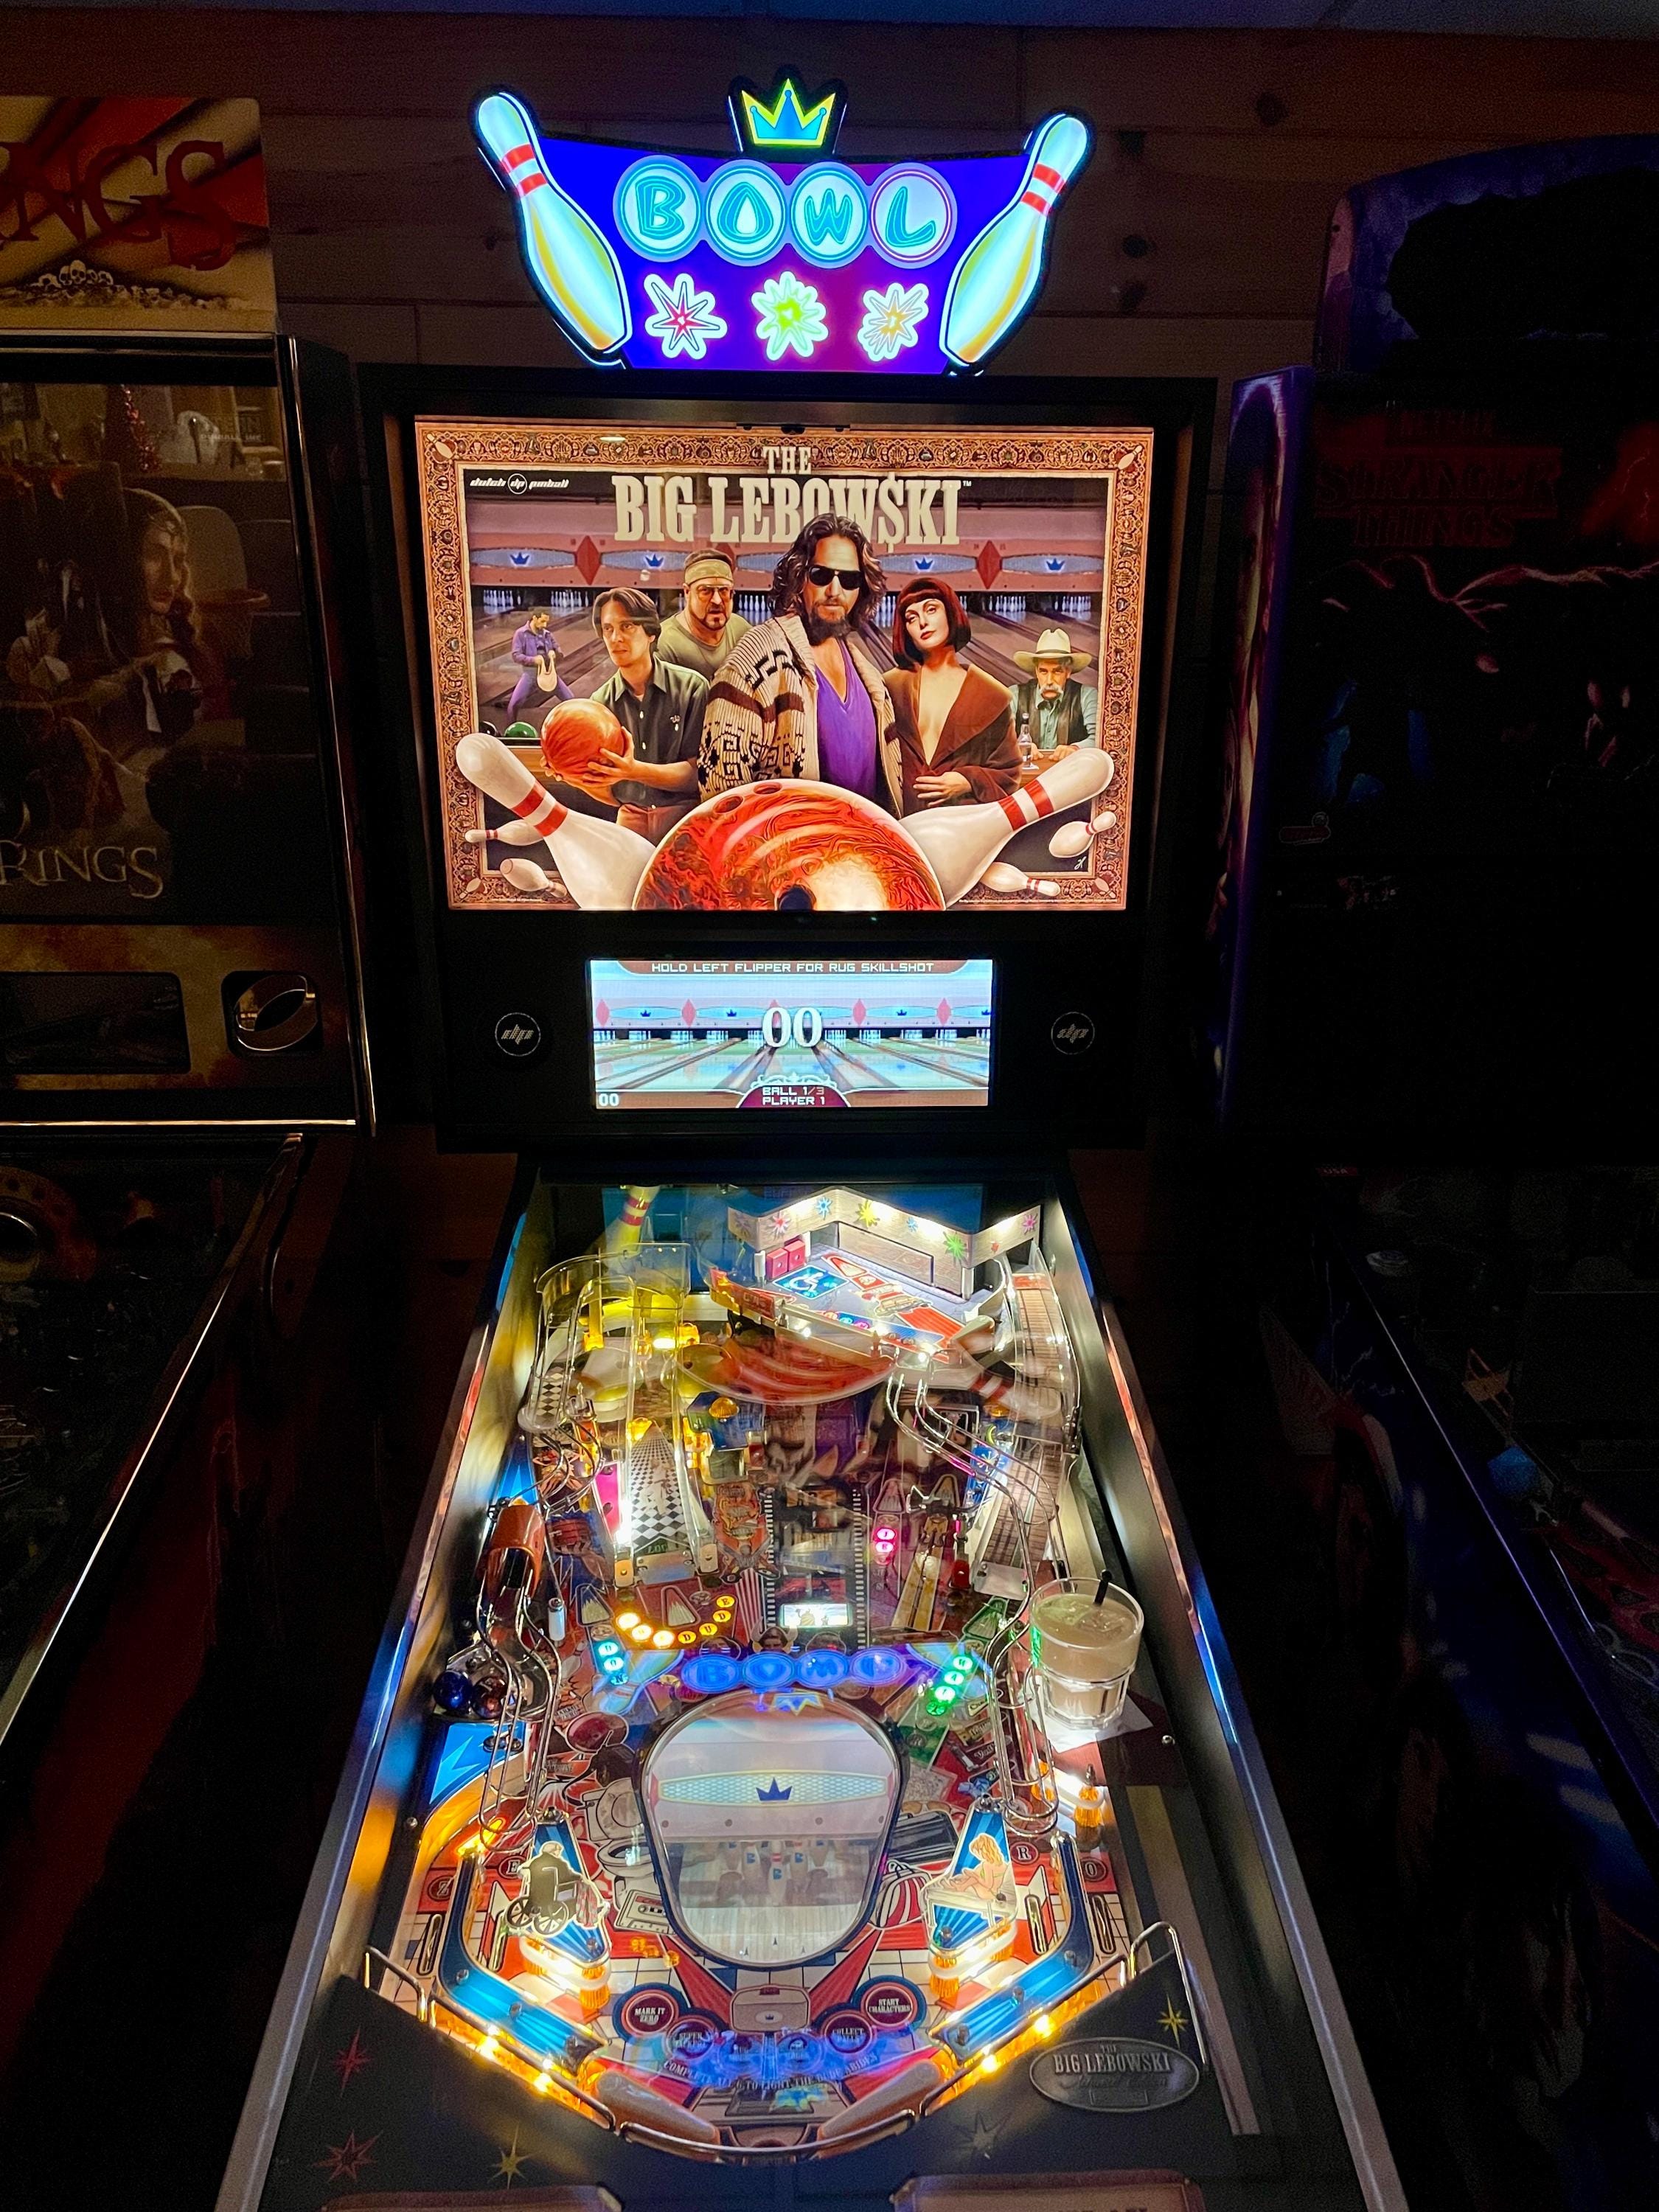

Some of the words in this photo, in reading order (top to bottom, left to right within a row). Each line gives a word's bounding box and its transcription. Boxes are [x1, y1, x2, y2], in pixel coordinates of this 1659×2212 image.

[0, 140, 237, 271] NGS
[633, 179, 936, 248] BOWL
[762, 446, 812, 474] THE
[611, 476, 697, 543] BIG
[651, 963, 688, 973] HOLD
[693, 963, 728, 973] LEFT
[734, 963, 791, 973] FLIPPER
[796, 963, 824, 972] FOR
[829, 963, 856, 972] RUG
[860, 962, 935, 972] SKILLSHOT
[762, 1006, 823, 1048] 00
[762, 1087, 798, 1096] BALL
[802, 1087, 825, 1096] 1/3
[598, 1093, 619, 1107] 00
[762, 1096, 815, 1105] PLAYER
[820, 1096, 825, 1105] 1
[1016, 1845, 1032, 1860] R
[878, 1998, 900, 2006] START
[634, 2007, 655, 2016] MARK
[657, 2006, 666, 2015] IT
[639, 2014, 660, 2025] ZERO
[1053, 2053, 1081, 2073] BIG
[1084, 2051, 1172, 2073] LEBOWSKI
